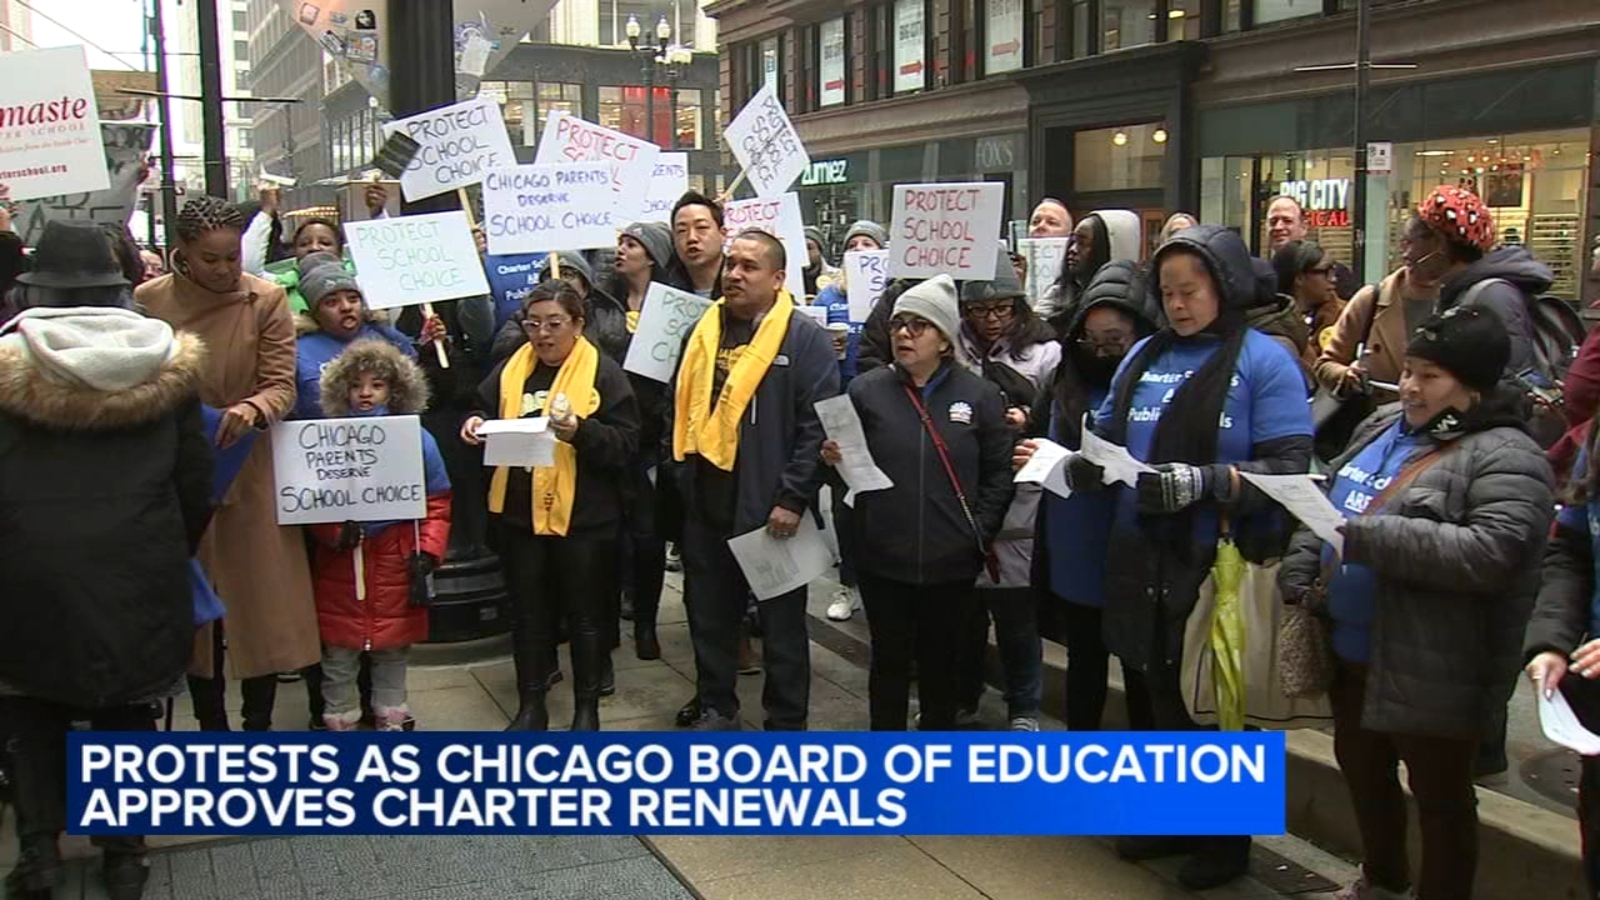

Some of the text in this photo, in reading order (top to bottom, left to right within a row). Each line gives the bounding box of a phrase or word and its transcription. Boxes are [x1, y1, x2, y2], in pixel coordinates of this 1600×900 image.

[31, 122, 86, 136] SCHOOL
[405, 105, 489, 140] PROTECT
[762, 95, 799, 156] PROTECT
[556, 118, 641, 161] PROTECT
[752, 115, 784, 176] SCHOOL
[435, 152, 501, 184] CHOICE
[743, 135, 774, 190] CHOICE
[486, 171, 550, 190] CHICAGO
[556, 169, 610, 185] PARENTS
[517, 192, 570, 207] DESERVE
[905, 188, 981, 213] PROTECT
[1310, 178, 1349, 210] CITY
[490, 211, 613, 237] SCHOOL CHOICE
[726, 202, 781, 224] ROTECT
[356, 221, 441, 249] PROTECT
[904, 216, 974, 243] SCHOOL
[377, 245, 456, 270] SCHOOL
[497, 264, 531, 275] Charter
[905, 246, 972, 269] CHOICE
[400, 267, 465, 291] CHOICE
[1127, 406, 1161, 422] Publi
[300, 423, 386, 449] CHICAGO
[306, 448, 378, 468] PARENTS
[316, 466, 371, 481] DESERVE
[280, 484, 421, 513] SCHOOL CHOICE
